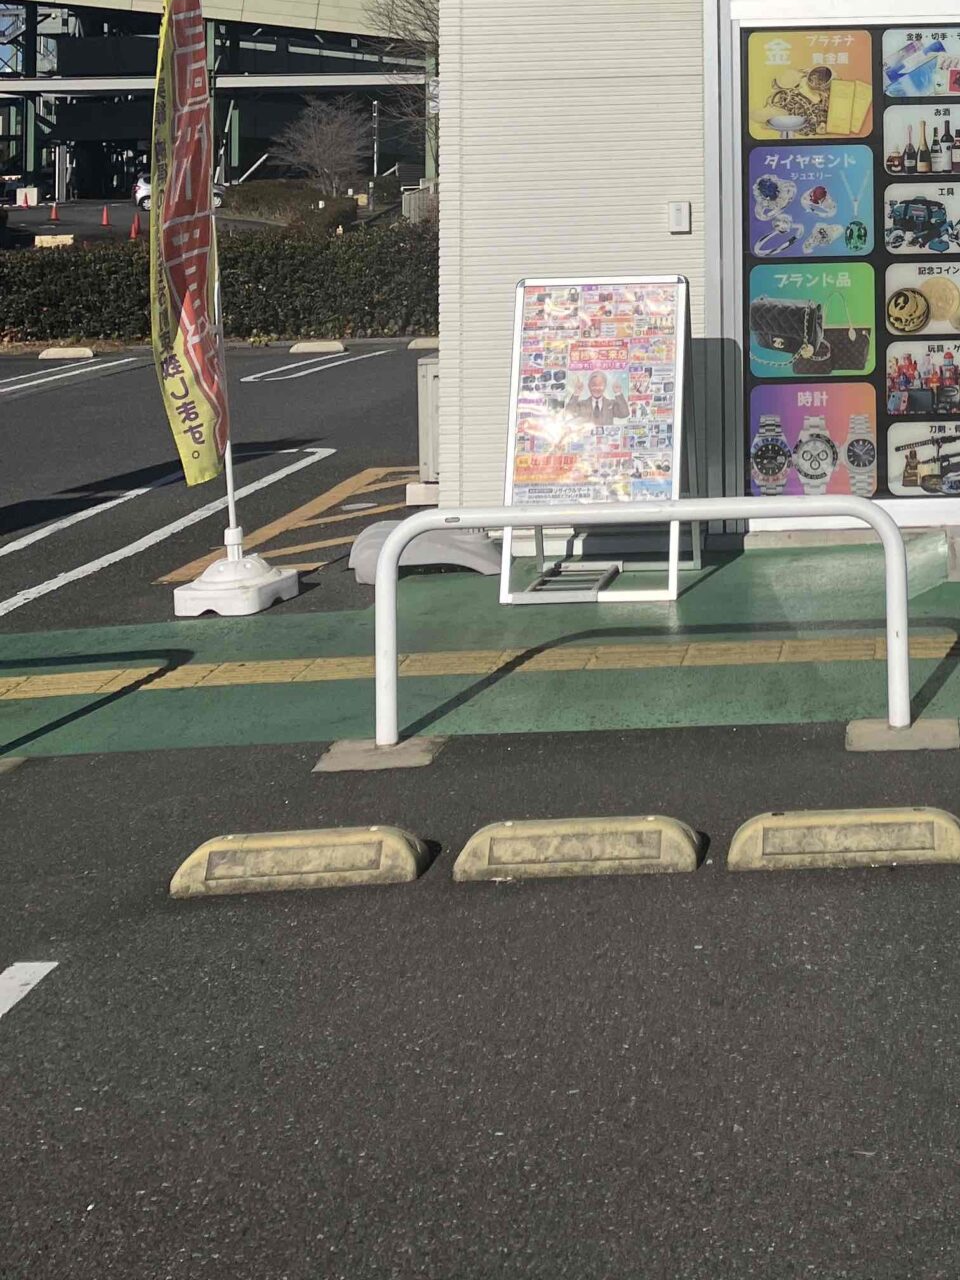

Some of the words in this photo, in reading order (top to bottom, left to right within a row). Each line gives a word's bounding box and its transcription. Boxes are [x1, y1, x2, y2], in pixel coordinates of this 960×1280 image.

[806, 34, 855, 48] プラチナ
[763, 38, 793, 66] 金
[934, 107, 951, 117] お酒
[764, 152, 857, 169] ダイヤモンド
[790, 171, 833, 181] ジュエリー
[937, 187, 955, 197] 工具
[773, 271, 852, 289] ブランド品
[797, 391, 829, 407] 時計
